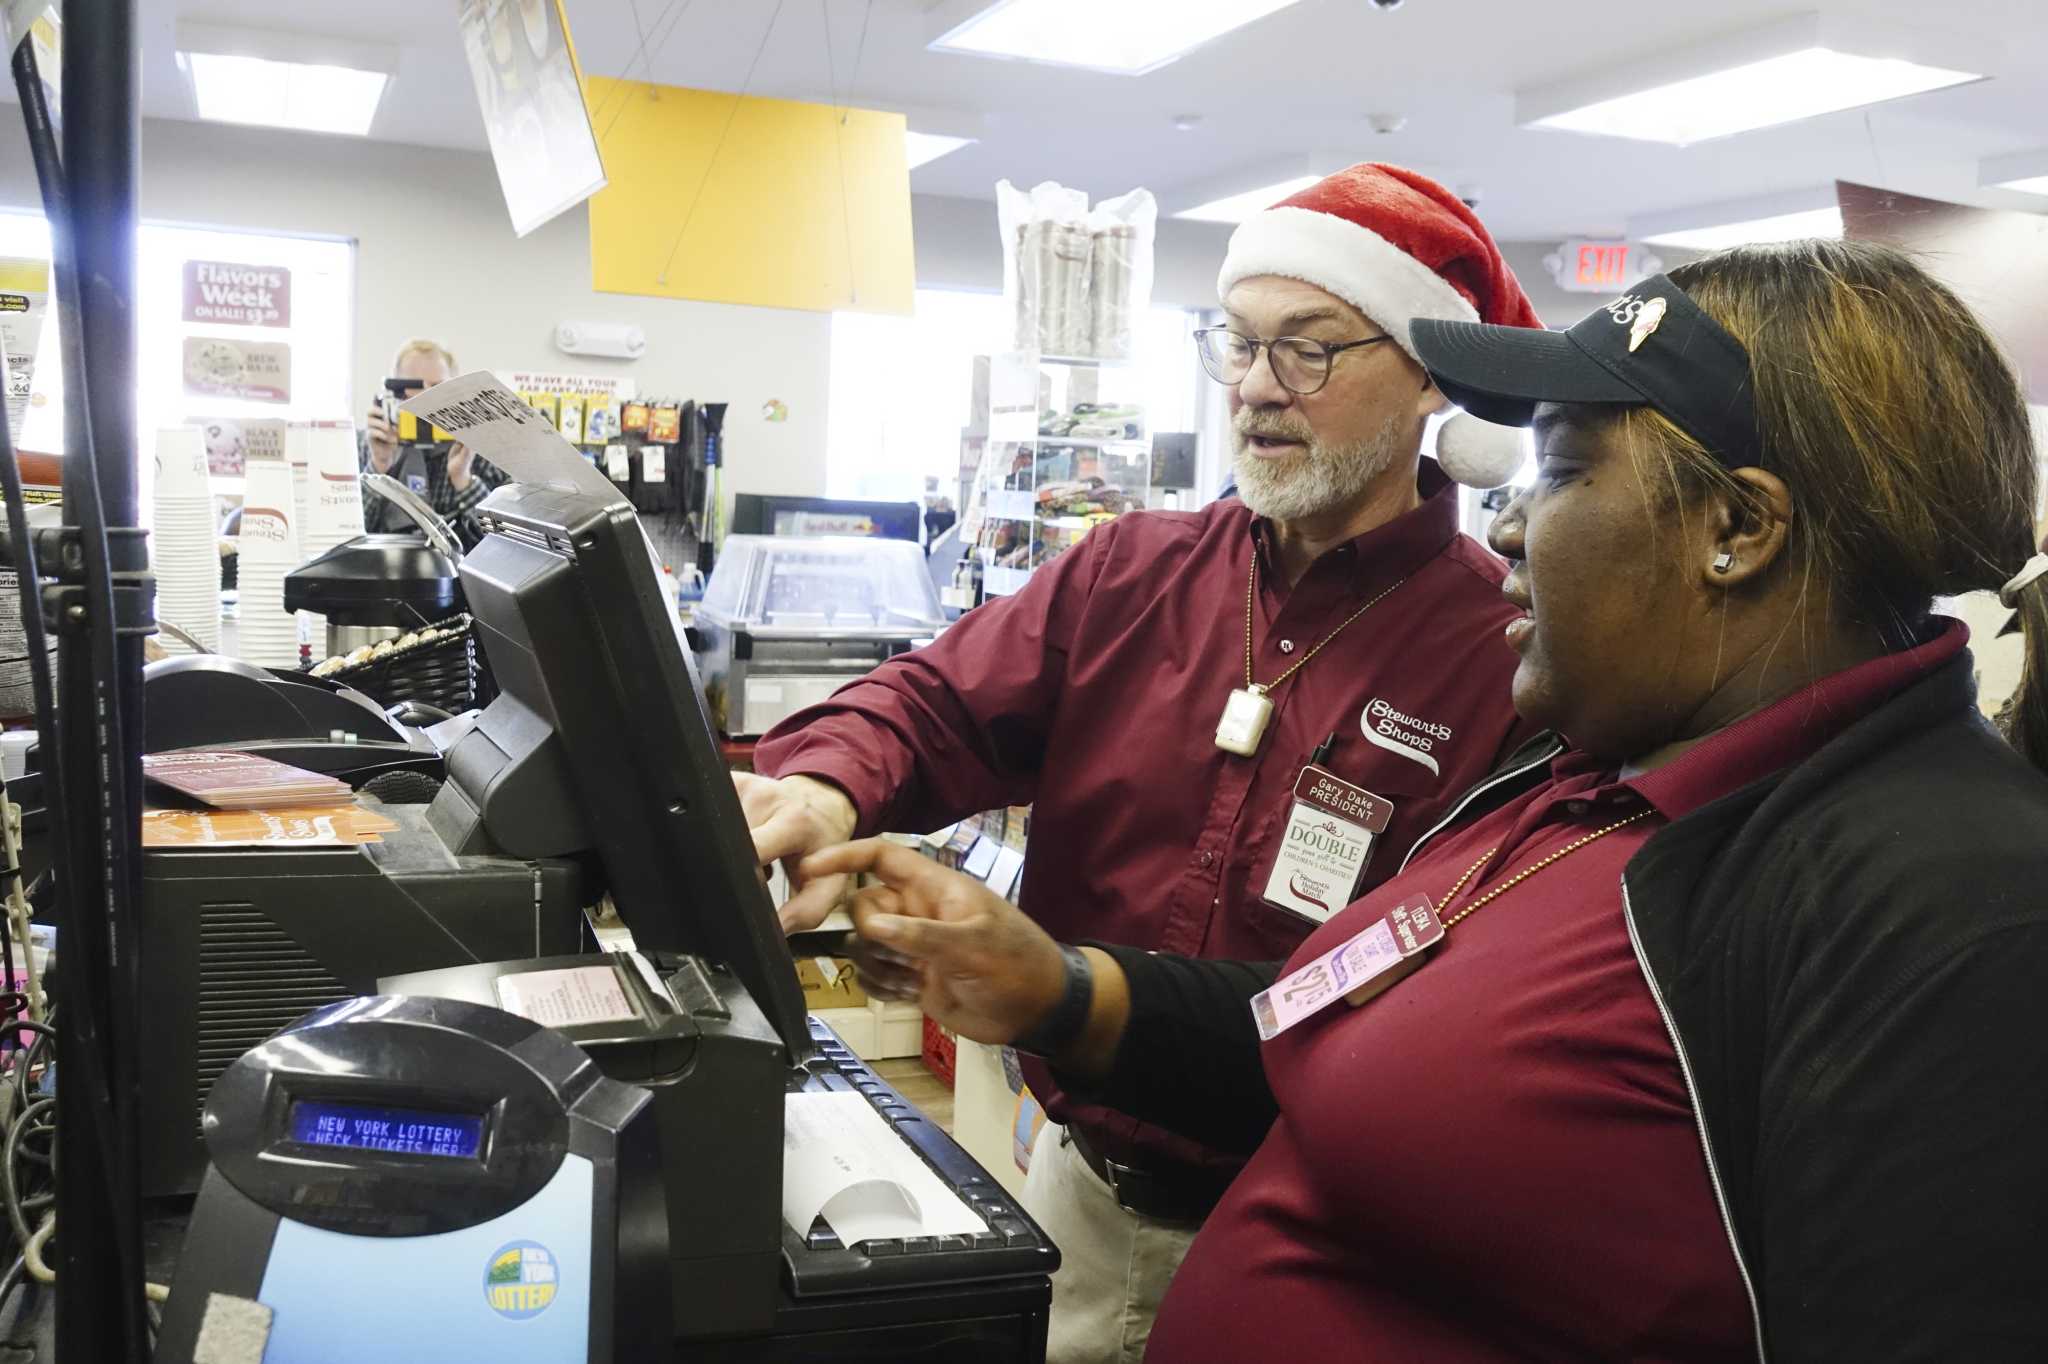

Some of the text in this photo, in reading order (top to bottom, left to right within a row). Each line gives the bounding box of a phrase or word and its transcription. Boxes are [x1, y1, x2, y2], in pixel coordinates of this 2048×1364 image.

[197, 263, 282, 288] Flavors
[1576, 246, 1629, 285] EXIT
[195, 304, 213, 318] ON
[201, 284, 273, 308] Week
[535, 375, 561, 384] HAVE
[1371, 700, 1452, 741] Stewart's
[1376, 719, 1433, 752] Shops
[1309, 786, 1374, 821] PRESIDENT
[1318, 778, 1374, 809] Gary Dake
[1290, 825, 1361, 863] DOUBLE
[318, 1115, 462, 1143] NEW YORK LOTTERY
